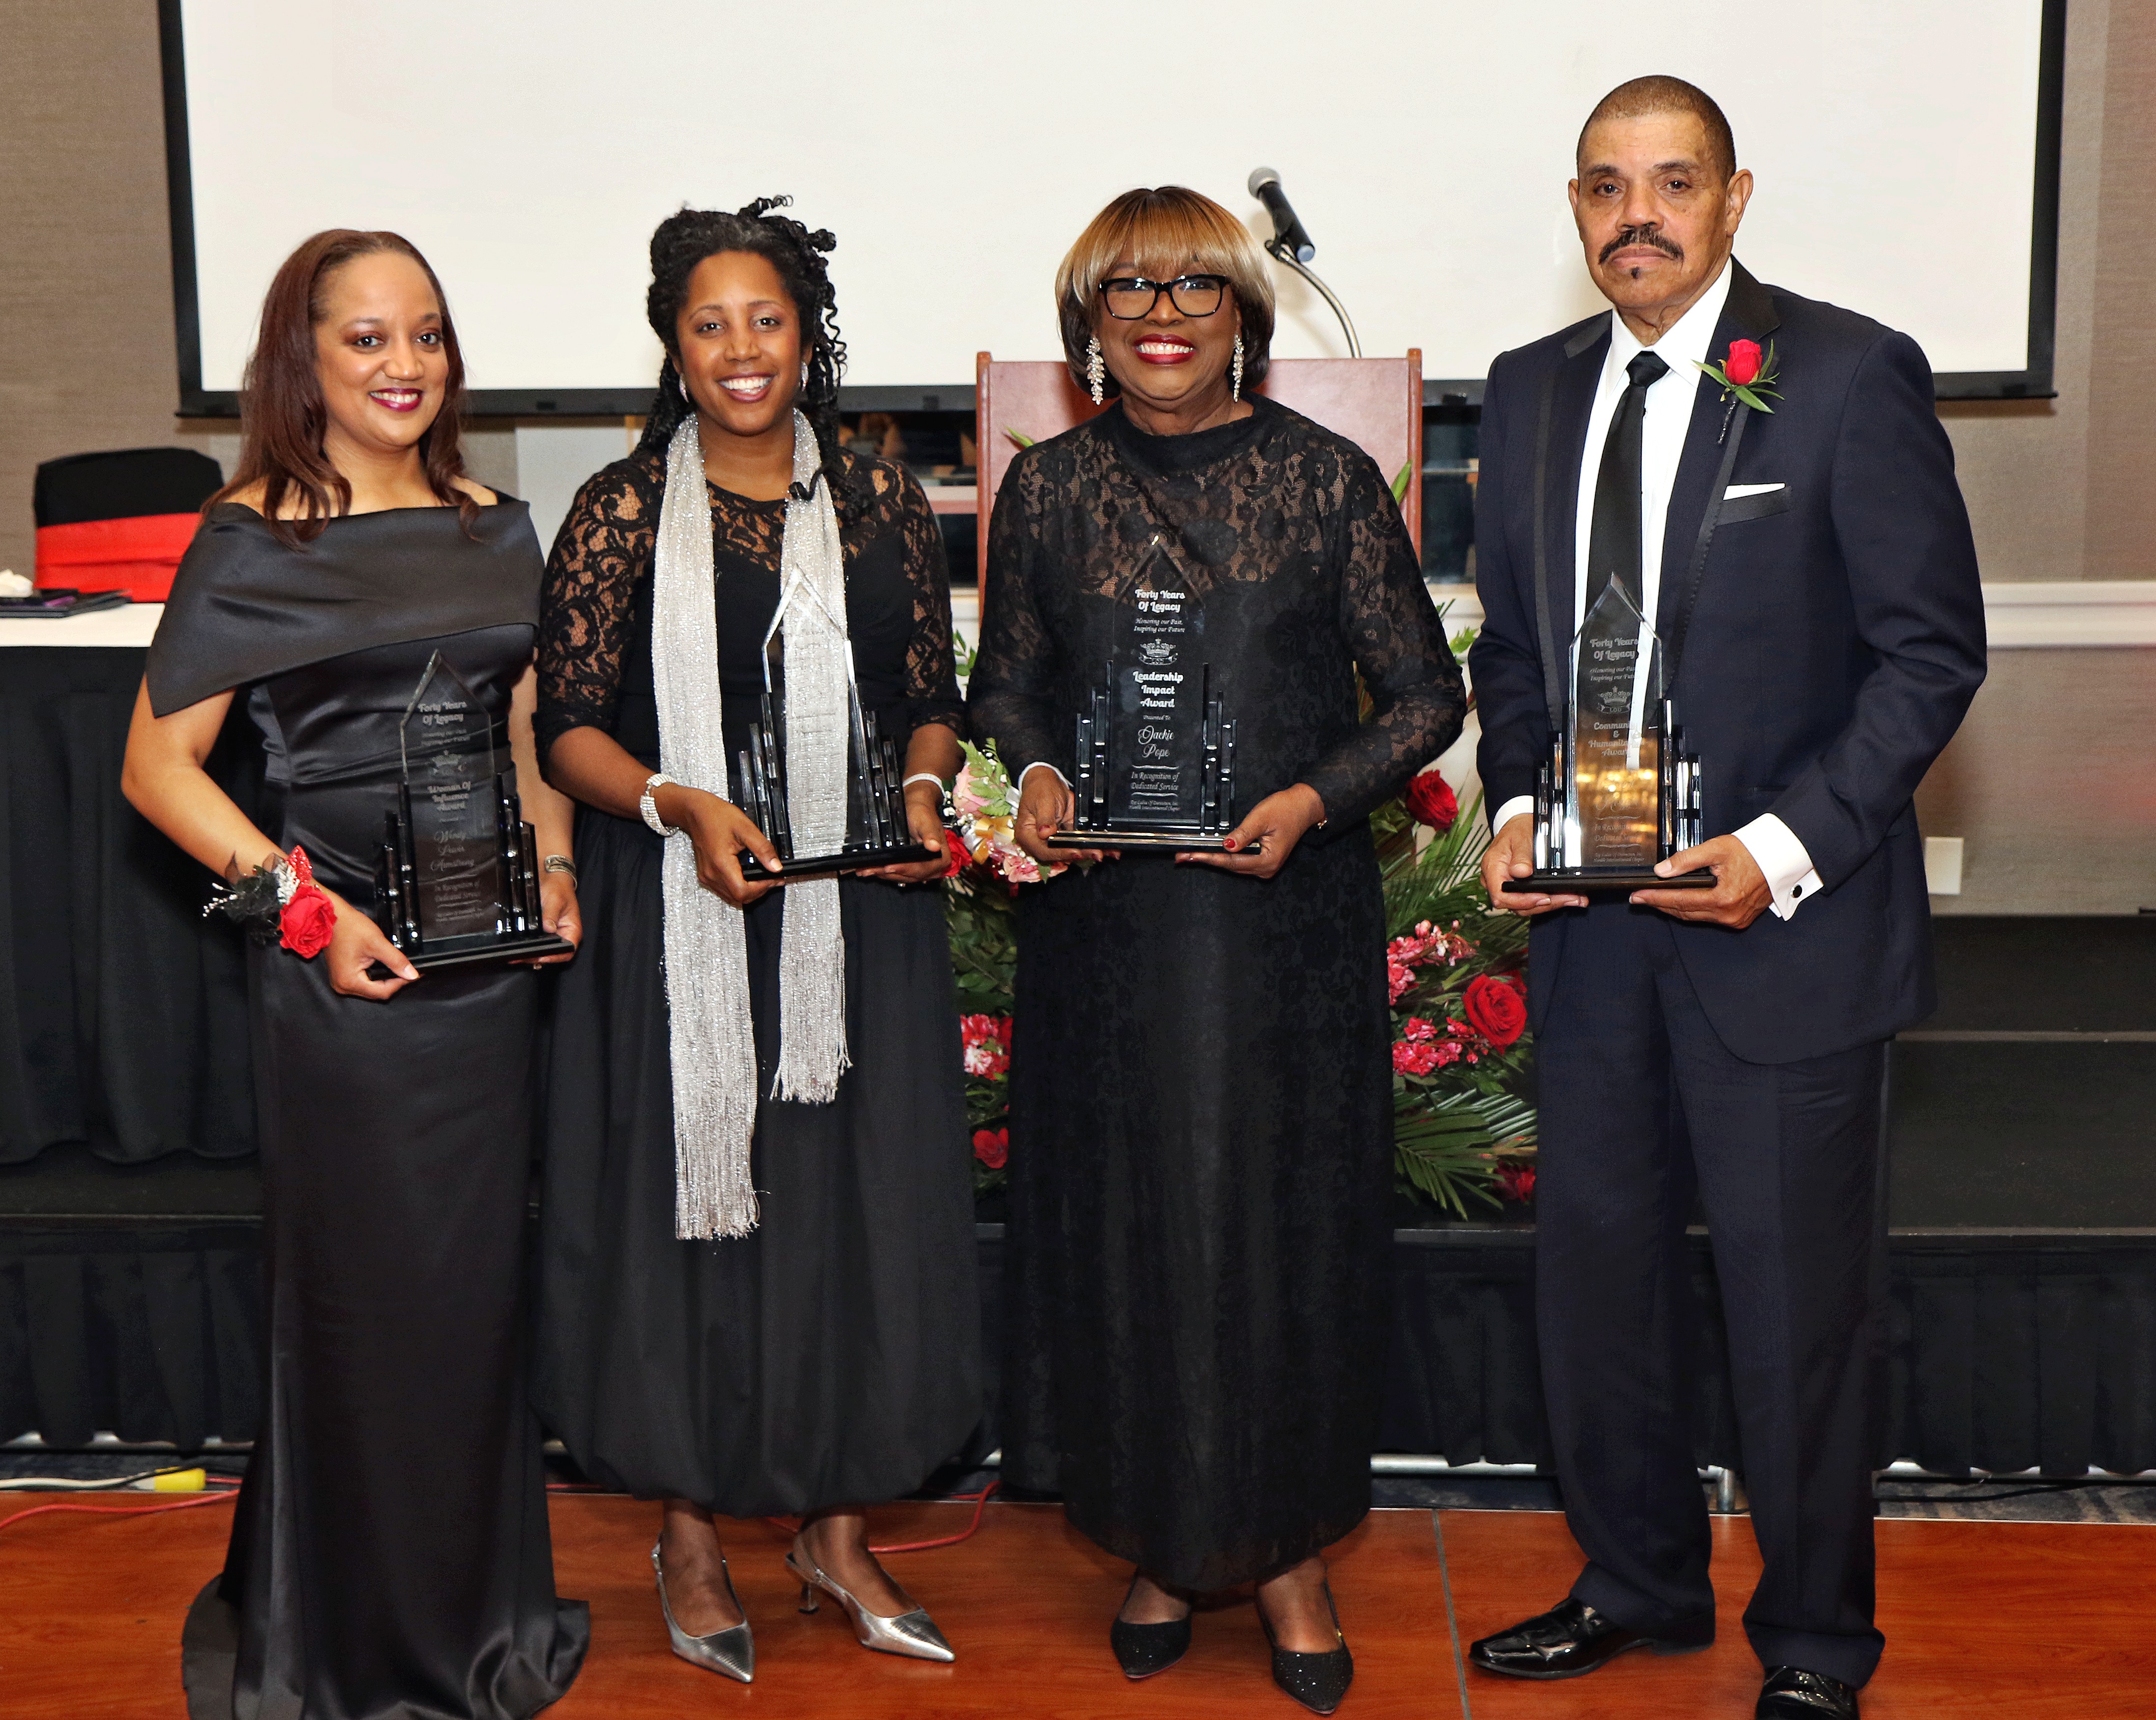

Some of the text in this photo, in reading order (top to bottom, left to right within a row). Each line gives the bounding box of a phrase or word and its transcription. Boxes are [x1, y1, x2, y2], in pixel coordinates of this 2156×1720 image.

[1135, 589, 1185, 600] Forty Years
[1138, 601, 1181, 613] Of Legacy
[1590, 638, 1613, 649] Forty
[1594, 650, 1635, 661] Of Legacy
[1132, 671, 1184, 683] Leadership
[1141, 684, 1176, 696] Impact
[1140, 698, 1175, 708] Award
